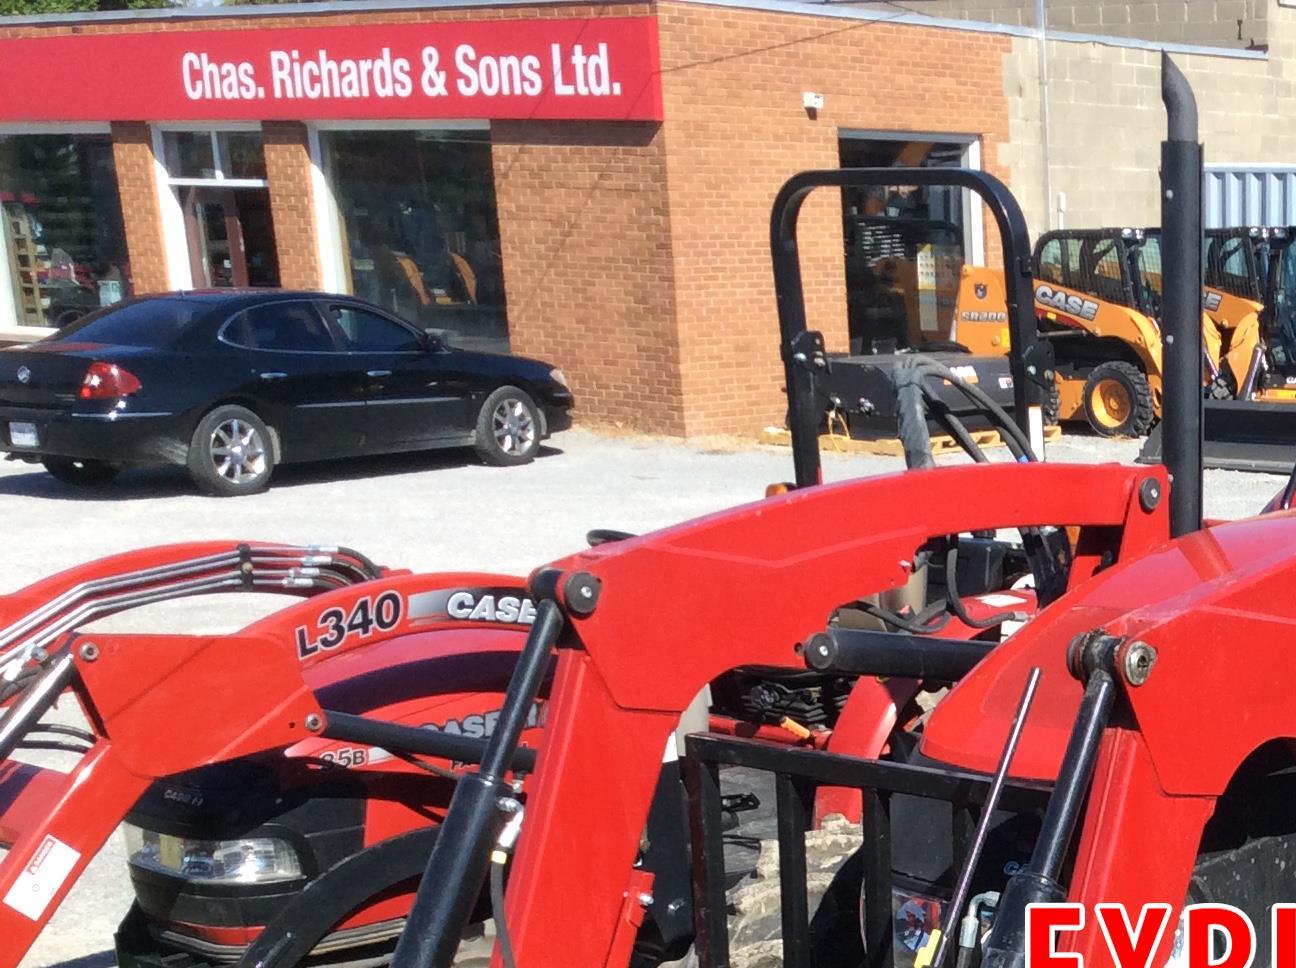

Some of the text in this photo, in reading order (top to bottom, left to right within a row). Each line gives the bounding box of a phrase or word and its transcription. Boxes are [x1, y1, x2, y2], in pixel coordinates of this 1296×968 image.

[182, 43, 621, 99] Chas. Richards & Sons Ltd.
[1035, 285, 1099, 321] CASE
[295, 590, 402, 660] L340
